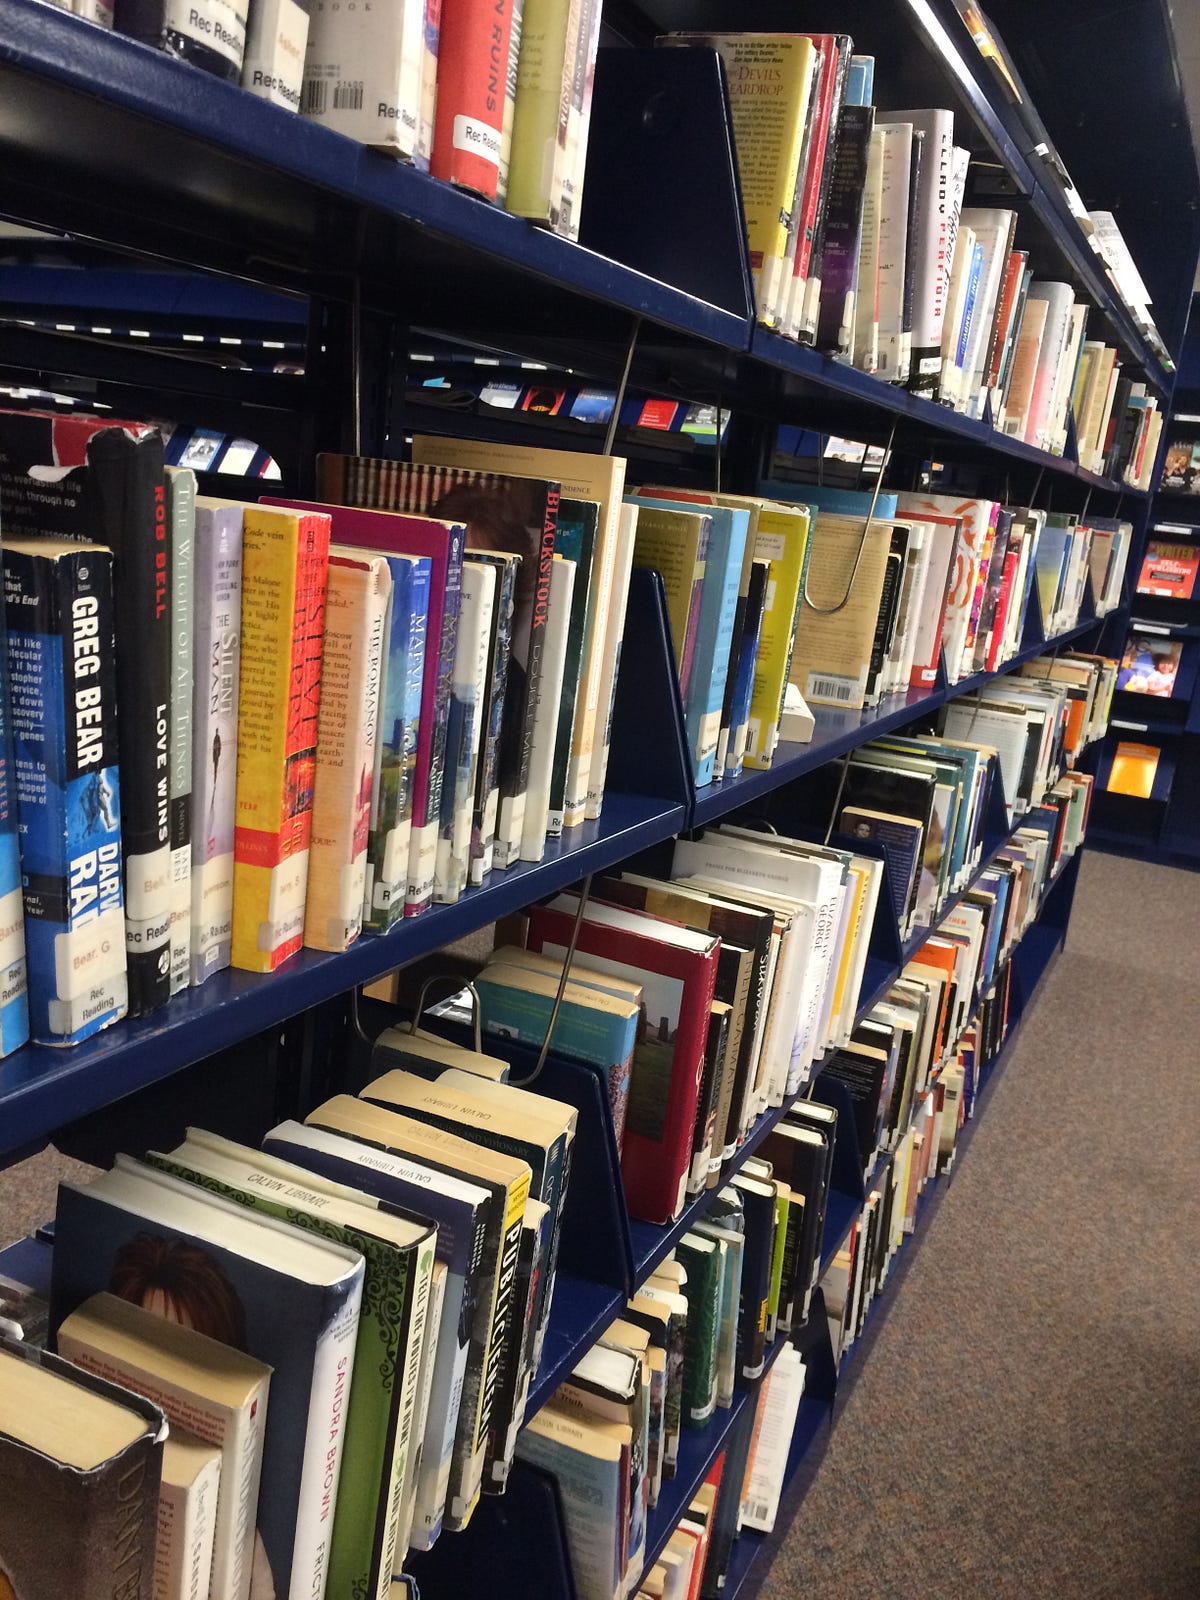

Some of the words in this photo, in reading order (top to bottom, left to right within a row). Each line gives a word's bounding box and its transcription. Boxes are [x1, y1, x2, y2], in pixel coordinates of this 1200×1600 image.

[189, 9, 212, 34] Rec
[213, 27, 244, 51] Readin
[505, 9, 523, 100] ATKINSO
[486, 24, 503, 112] RUINS
[252, 71, 278, 88] Rec
[730, 82, 784, 96] EARDROP
[377, 103, 400, 118] Rec
[465, 126, 481, 142] Rec
[937, 134, 948, 214] ELLROY
[932, 222, 947, 318] PERFIDIA
[66, 481, 82, 492] life
[561, 484, 592, 494] NDENCE
[26, 490, 61, 507] through
[64, 498, 76, 508] no
[178, 484, 190, 528] THE
[153, 486, 166, 541] ROB
[266, 531, 285, 540] vein
[533, 491, 561, 629] BLACKSTOCK
[1155, 544, 1194, 559] WRITER
[155, 552, 167, 619] BELL
[176, 539, 191, 624] WEIGHT
[22, 596, 39, 606] End
[215, 615, 230, 628] THE
[9, 638, 21, 647] ait
[23, 638, 42, 649] like
[72, 596, 101, 678] GREG
[177, 630, 190, 659] OF
[343, 642, 353, 650] of
[410, 615, 427, 694] MAEVE
[16, 663, 26, 672] if
[26, 663, 43, 672] her
[221, 632, 239, 718] SILENT
[340, 671, 350, 680] of
[11, 673, 43, 687] stopher
[176, 666, 191, 704] ALL
[210, 641, 221, 715] MAN
[526, 645, 542, 720] DOUBLE
[19, 696, 44, 707] down
[337, 702, 347, 711] by
[365, 656, 379, 747] ROMANOV
[13, 708, 44, 722] scovery
[75, 686, 104, 769] BEAR
[337, 720, 347, 729] of
[20, 731, 45, 742] genes
[155, 703, 169, 770] LOVE
[176, 708, 191, 790] THINGS
[519, 730, 533, 785] MIND
[16, 761, 32, 770] tens
[37, 761, 46, 771] to
[327, 758, 344, 768] and
[16, 773, 46, 783] against
[18, 784, 46, 794] uipped
[39, 795, 47, 804] of
[157, 777, 170, 843] WINS
[27, 906, 45, 915] Year
[127, 933, 143, 943] ec
[146, 925, 171, 942] Read
[811, 903, 825, 953] GEORGE
[821, 895, 838, 961] ELIZABETH
[101, 940, 111, 953] G
[173, 948, 187, 960] Rec
[8, 967, 23, 981] Rec
[172, 958, 191, 973] eadin
[90, 987, 105, 1001] Rec
[83, 996, 115, 1020] Reading
[423, 1095, 455, 1112] LIBRARY
[460, 1106, 493, 1121] CALVIN
[356, 1153, 396, 1173] LIBRARY
[397, 1167, 432, 1185] CALVIN
[247, 1172, 285, 1192] CALVIN
[284, 1183, 330, 1209] LIBRARY
[492, 1222, 523, 1346] PUBLIC
[414, 1276, 429, 1312] TELL
[411, 1310, 424, 1337] THE
[403, 1336, 421, 1389] WOLVES
[327, 1356, 347, 1442] SANDRA
[559, 1392, 585, 1409] Truth
[204, 1410, 226, 1425] Brown
[398, 1413, 412, 1450] HOME
[555, 1424, 584, 1440] LIBRARY
[319, 1448, 337, 1522] BROWN
